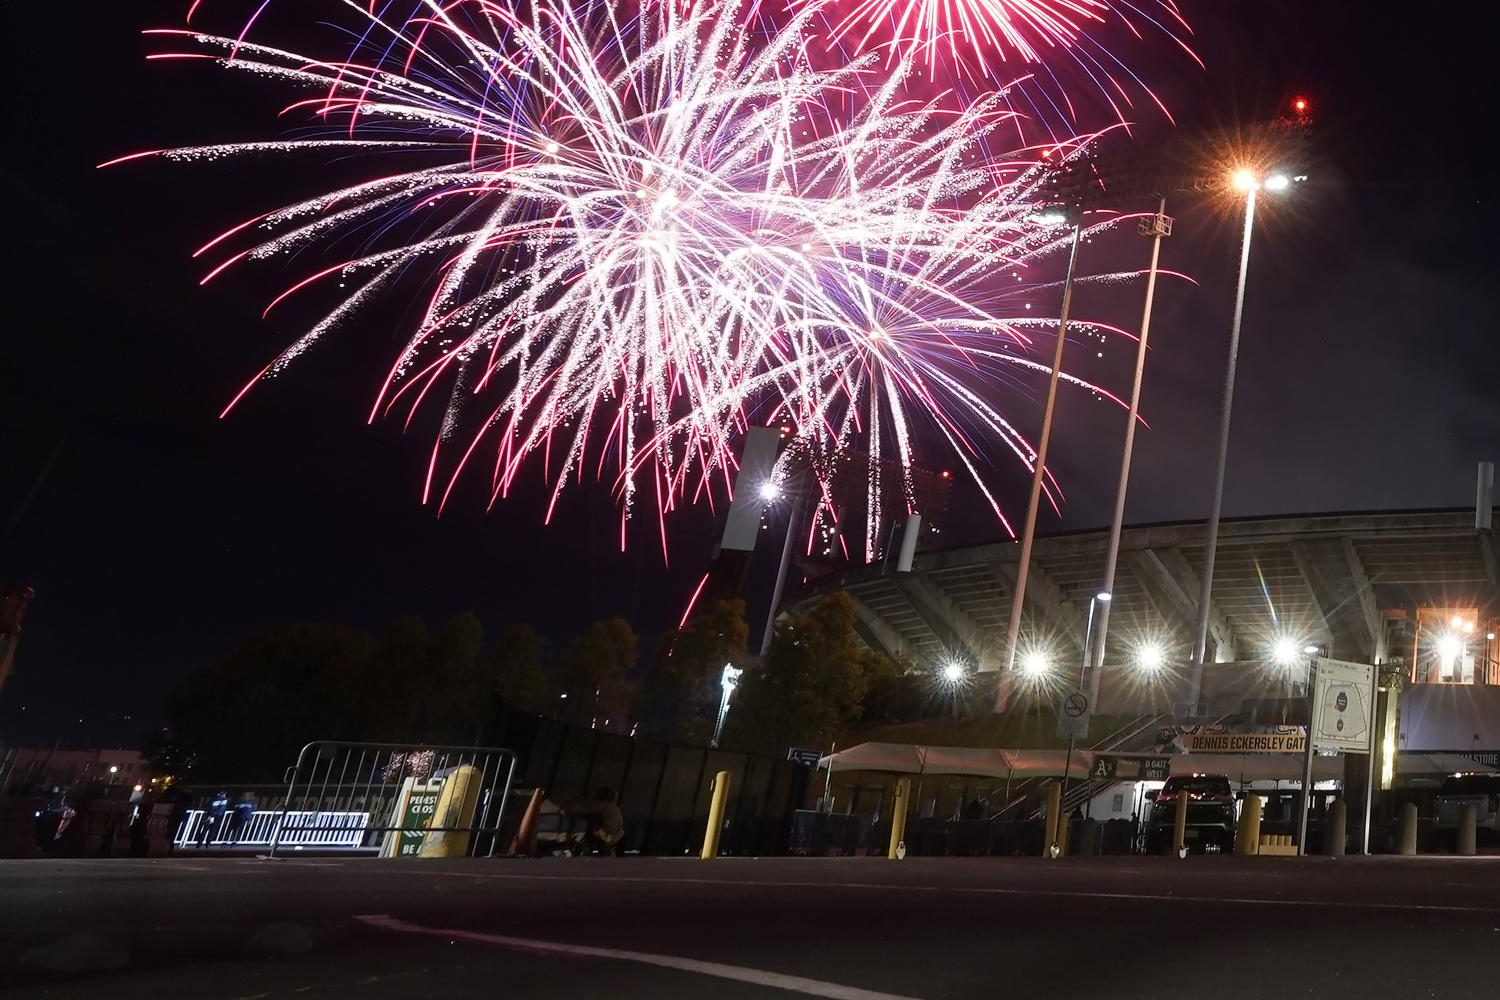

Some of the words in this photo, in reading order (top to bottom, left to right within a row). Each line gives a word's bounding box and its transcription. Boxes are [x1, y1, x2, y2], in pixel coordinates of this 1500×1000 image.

[1192, 737, 1228, 749] DENNIS
[1230, 737, 1283, 749] ECKERSLEY
[1286, 738, 1305, 749] GAT
[1474, 754, 1498, 764] STORE
[409, 796, 437, 805] PEDEST
[402, 844, 416, 854] BE
